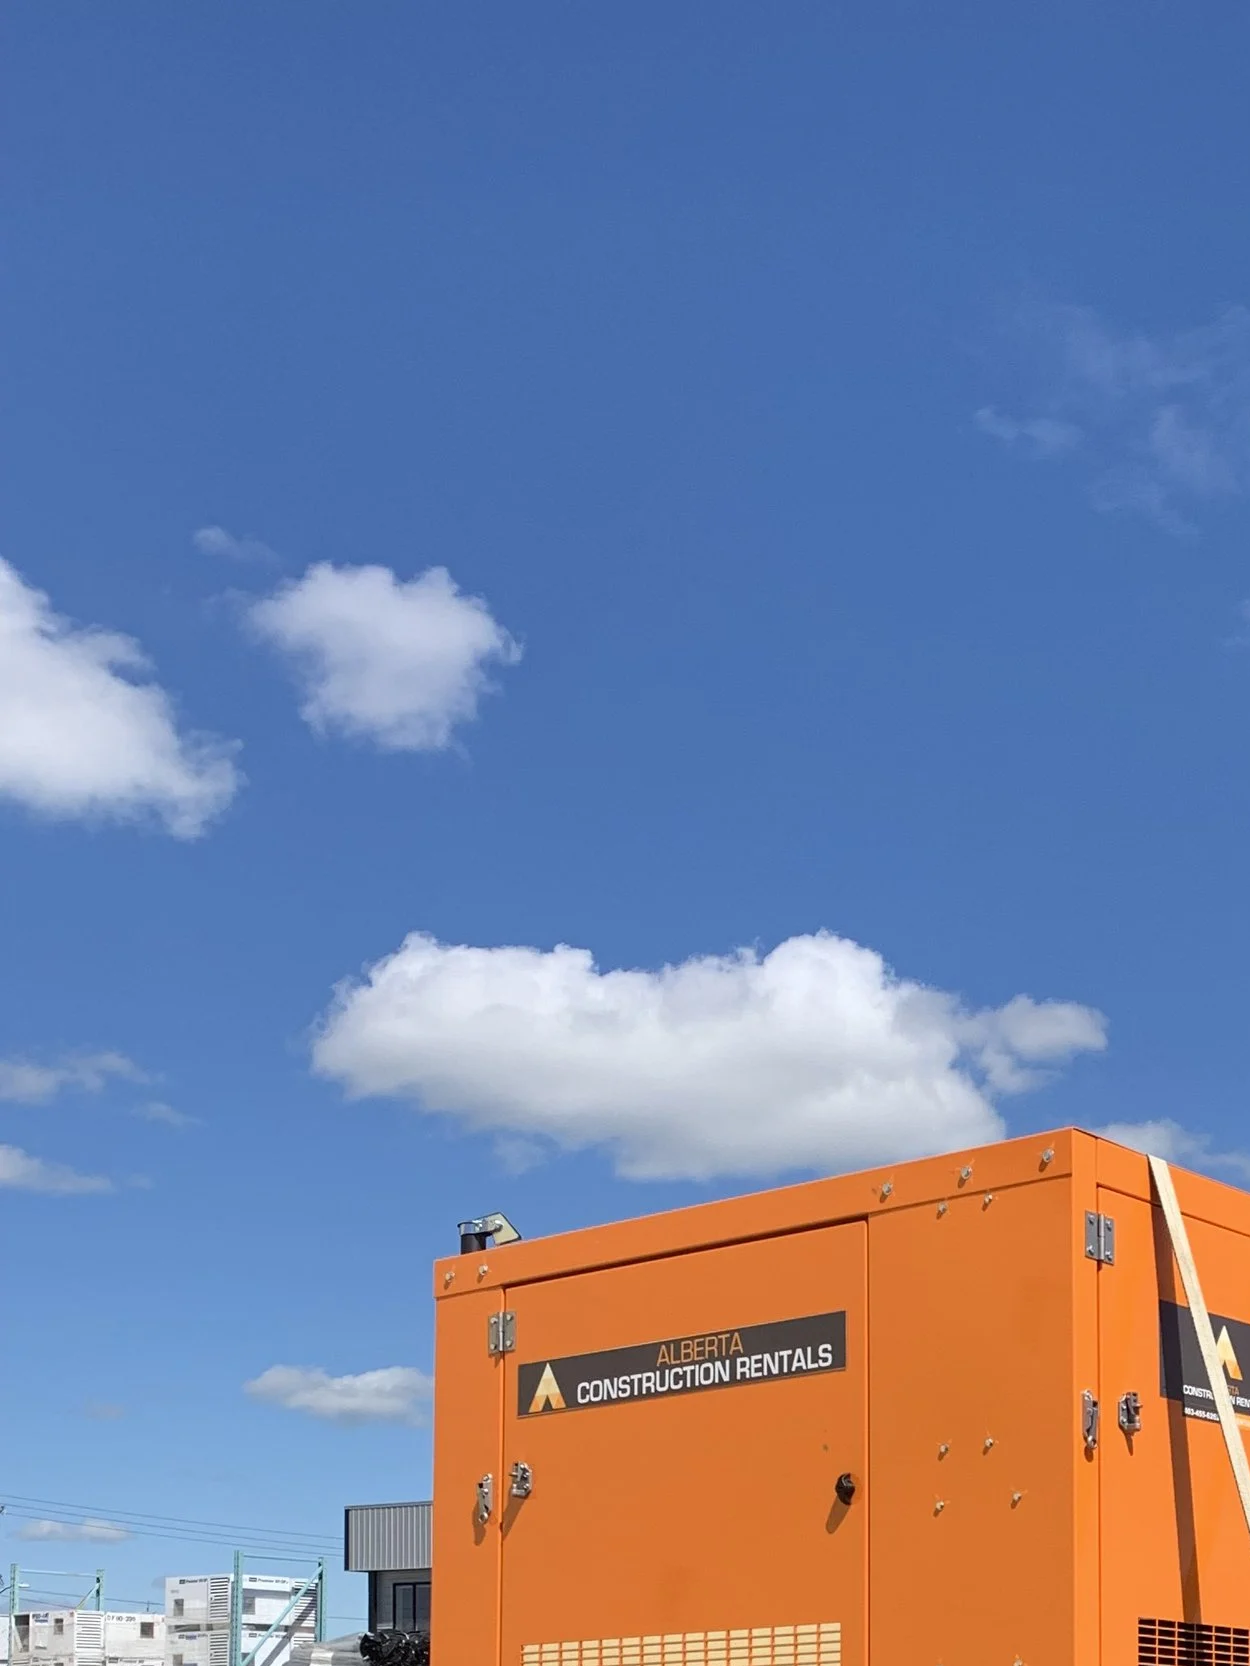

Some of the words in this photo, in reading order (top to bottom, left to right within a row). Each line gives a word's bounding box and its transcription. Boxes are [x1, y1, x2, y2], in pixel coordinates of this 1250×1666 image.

[577, 1359, 731, 1404] CONSTRUCTION
[735, 1343, 833, 1380] RENTALS
[656, 1332, 744, 1367] ALBERTA
